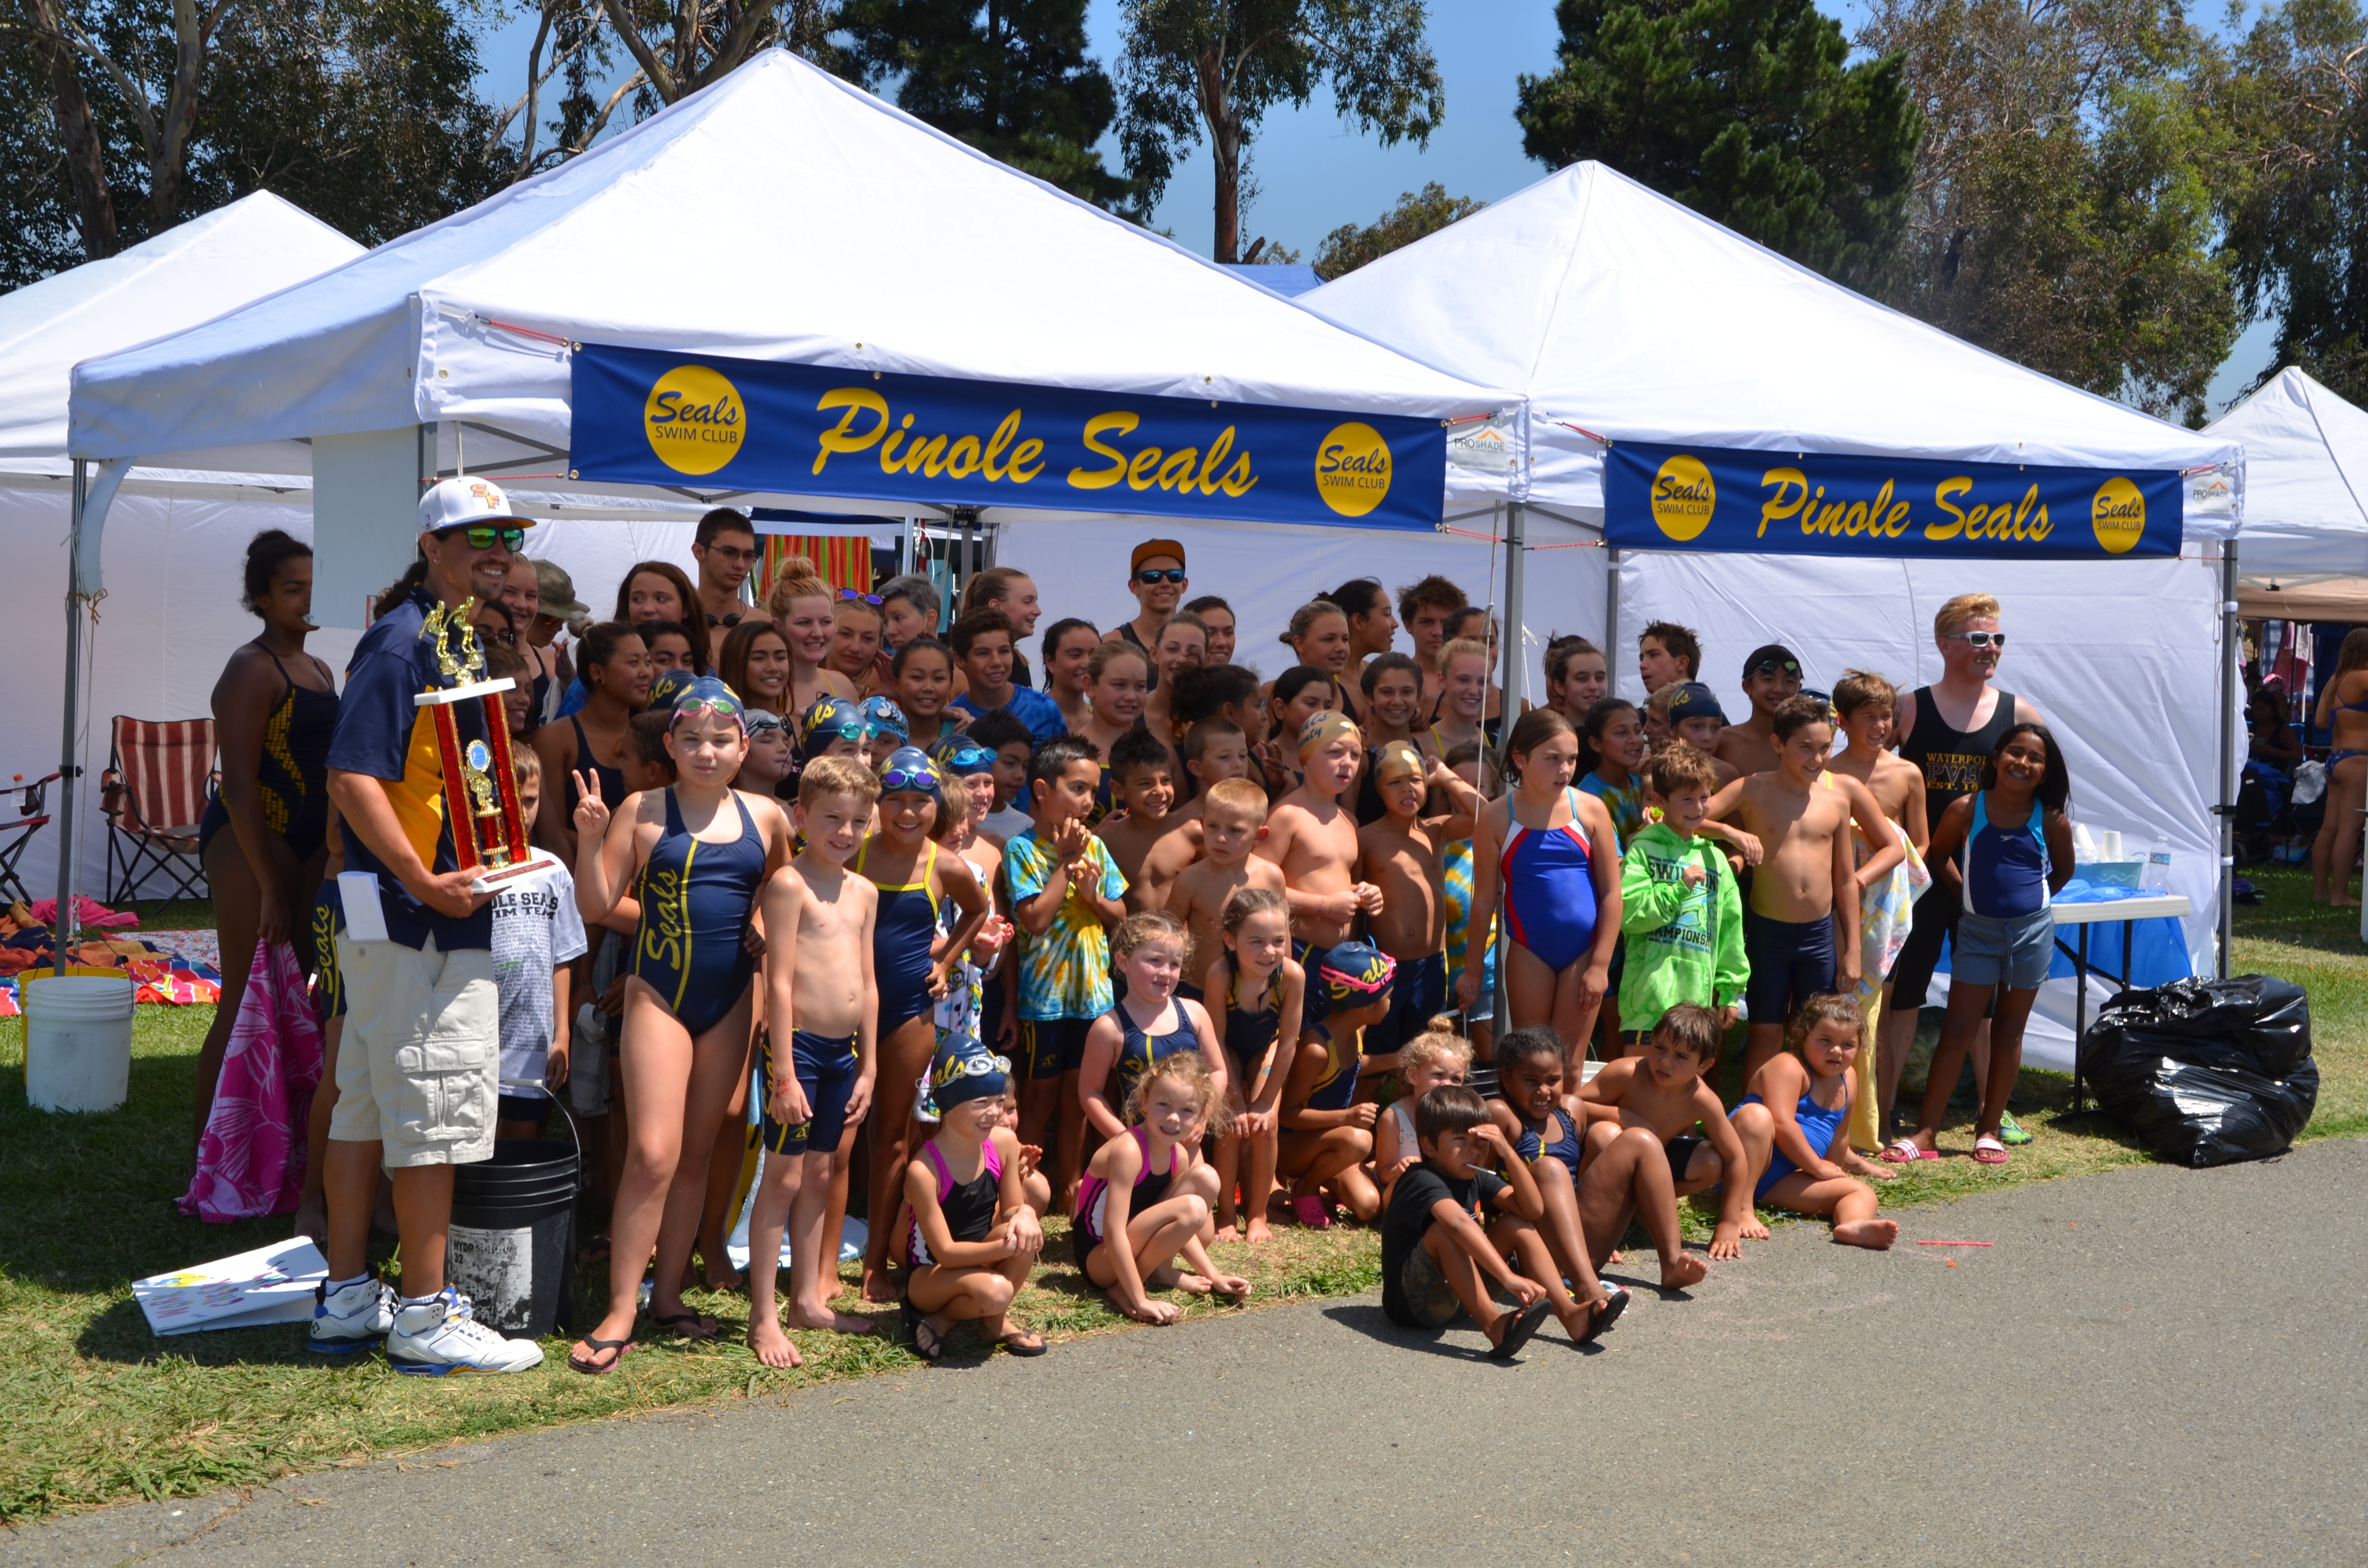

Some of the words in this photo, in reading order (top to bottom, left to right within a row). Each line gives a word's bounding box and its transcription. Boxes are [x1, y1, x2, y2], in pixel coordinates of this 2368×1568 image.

[650, 391, 740, 426] Seals
[655, 425, 696, 441] SWIM
[702, 429, 738, 443] CLUB
[813, 388, 1045, 483] Pinole
[1067, 411, 1258, 497] Seals
[1455, 438, 1505, 451] PROSHADE
[1320, 444, 1388, 474] Seals
[1323, 475, 1355, 487] SWIM
[1358, 477, 1385, 489] CLUB
[1655, 475, 1712, 501] Seals
[1658, 503, 1684, 514] SWIM
[1687, 504, 1710, 515] CLUB
[1756, 467, 1911, 538] Pinole
[1924, 476, 2054, 541] Seals
[2096, 496, 2142, 519] Seals
[2098, 520, 2119, 530] SWIM
[2122, 521, 2141, 531] CLUB
[1926, 753, 1987, 765] WATERPOL
[1926, 762, 1984, 784] PVH
[1926, 782, 1958, 790] EST.
[1963, 783, 1980, 792] 19
[494, 907, 518, 919] IM
[646, 869, 681, 970] Seals
[313, 904, 333, 994] Seals
[454, 1252, 464, 1264] 32
[312, 1322, 321, 1335] 23
